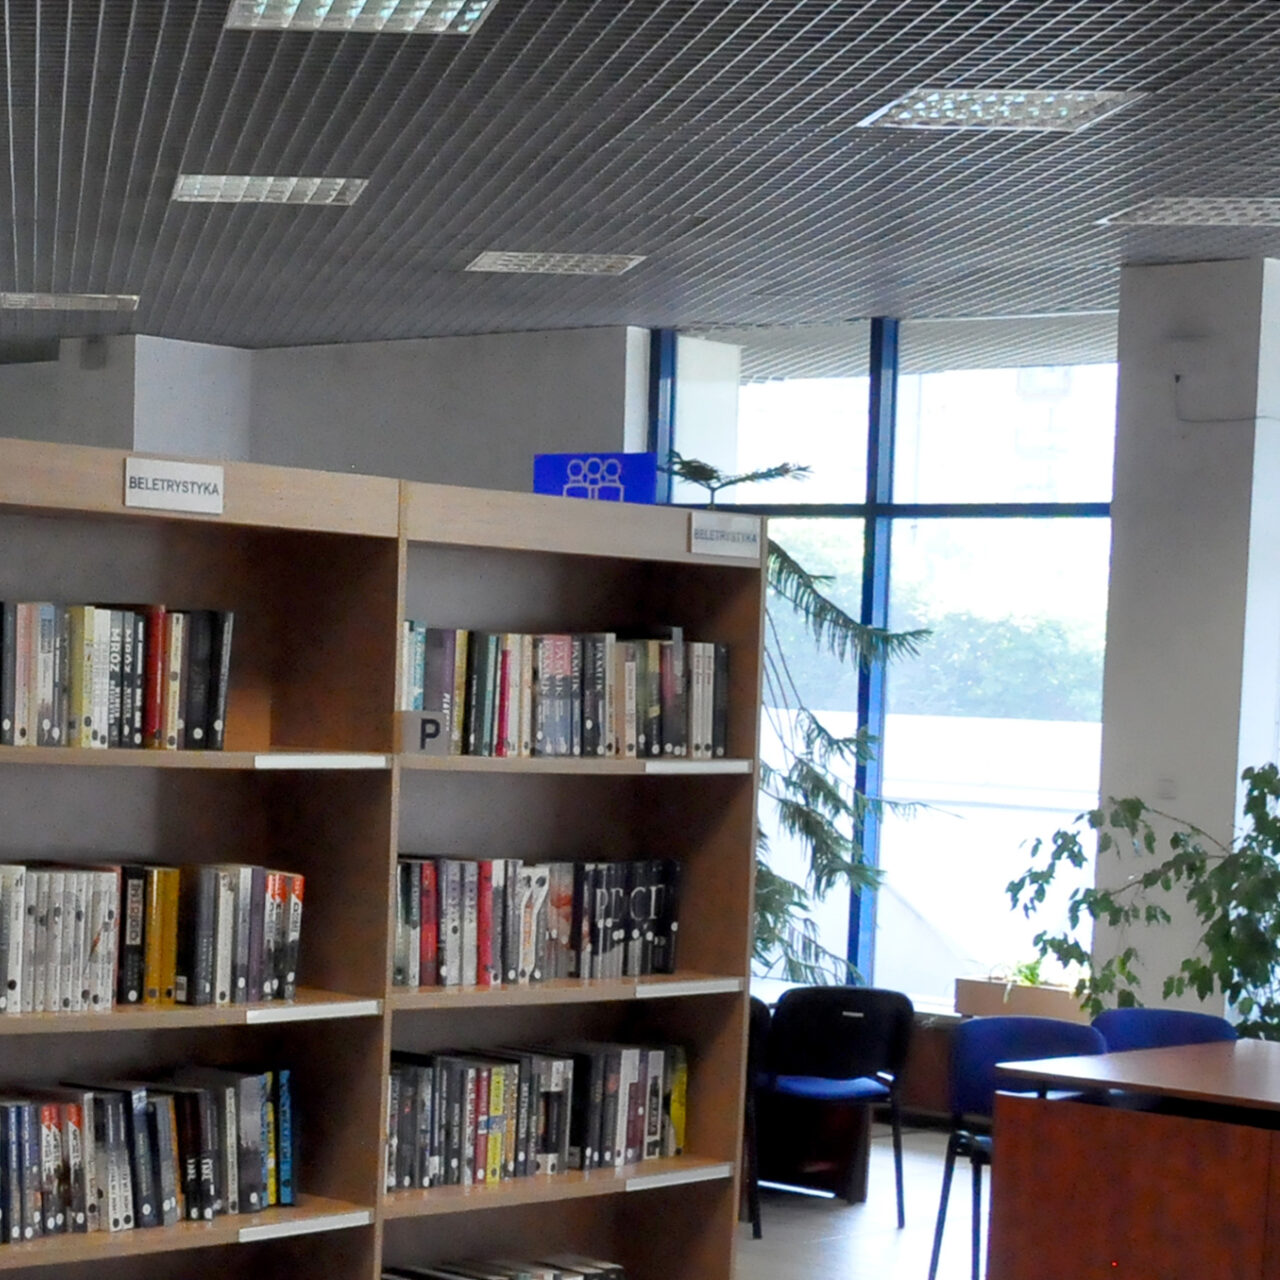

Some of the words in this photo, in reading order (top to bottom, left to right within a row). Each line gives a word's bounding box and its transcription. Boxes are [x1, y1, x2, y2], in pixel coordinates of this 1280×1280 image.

[128, 476, 220, 497] BELETRYSTYKA
[110, 627, 123, 673] MRÓZ
[420, 717, 441, 750] P
